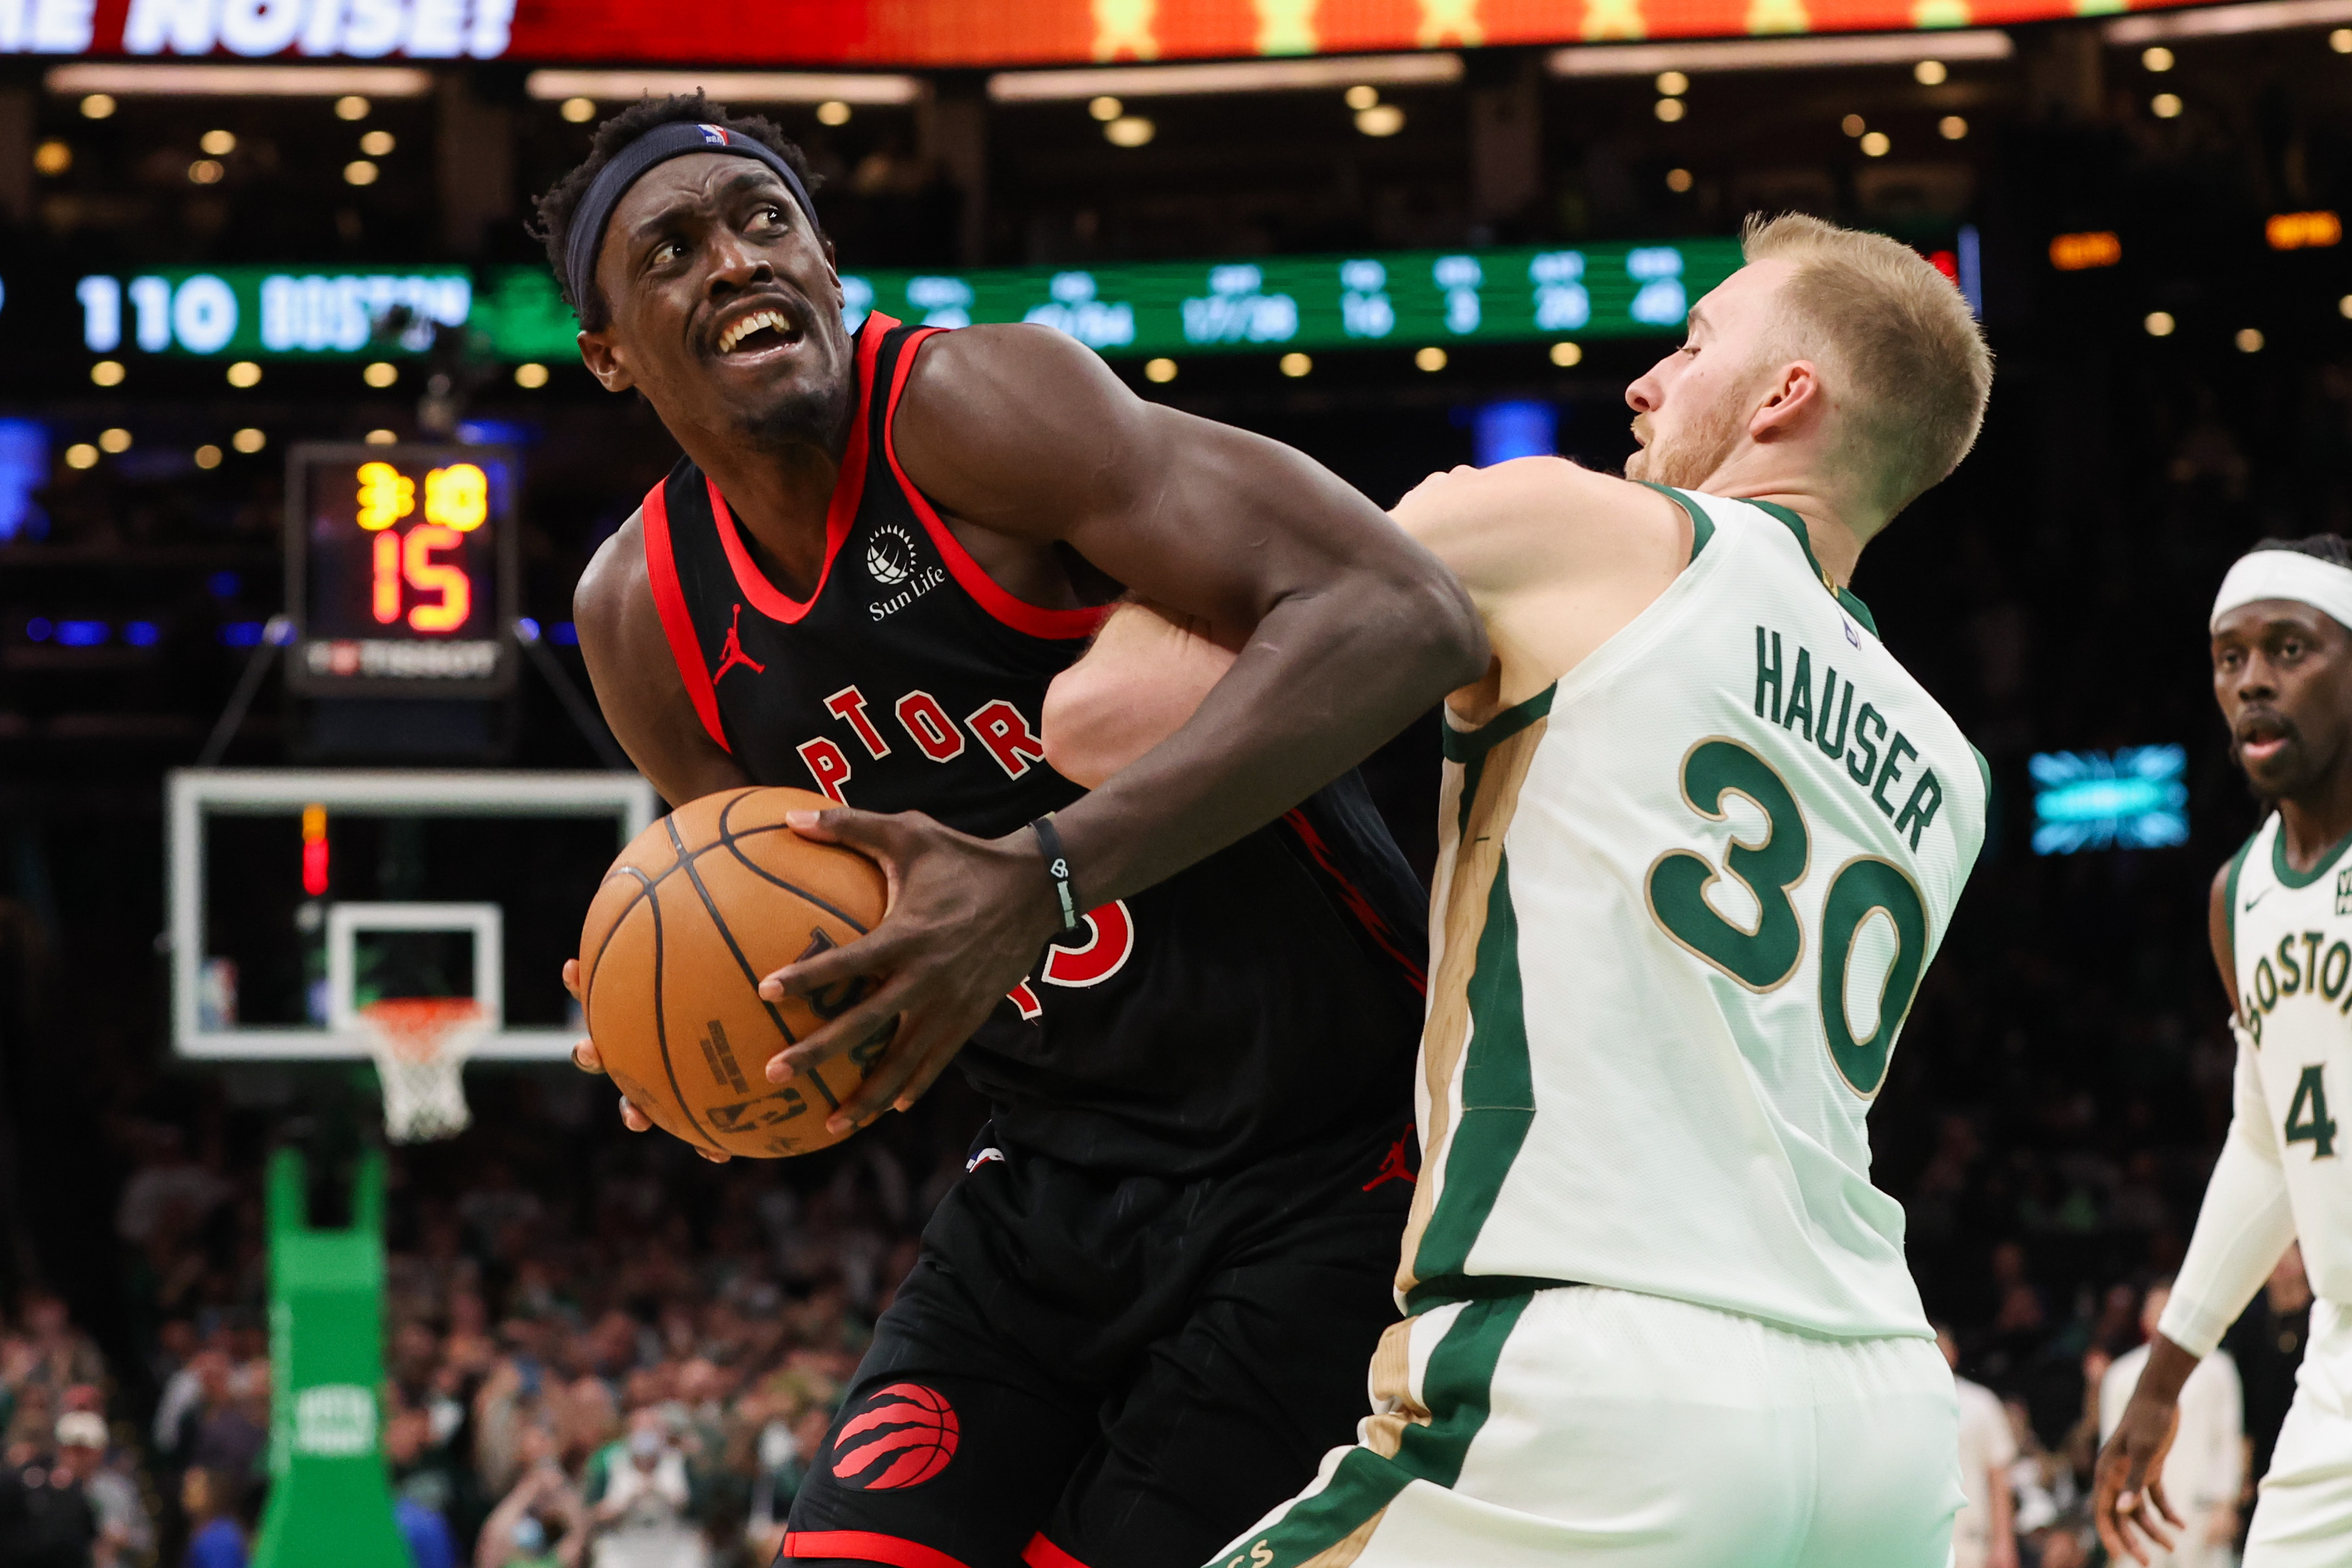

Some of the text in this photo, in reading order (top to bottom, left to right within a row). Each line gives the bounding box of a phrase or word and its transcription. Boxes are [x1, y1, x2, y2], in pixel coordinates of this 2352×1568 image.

[76, 274, 240, 354] 110
[374, 523, 471, 633] 15
[869, 566, 945, 621] Sun Life
[796, 684, 1045, 808] PTOR
[1754, 624, 1942, 854] HAUSER
[1644, 735, 1931, 1101] 30
[2285, 1063, 2339, 1162] 4
